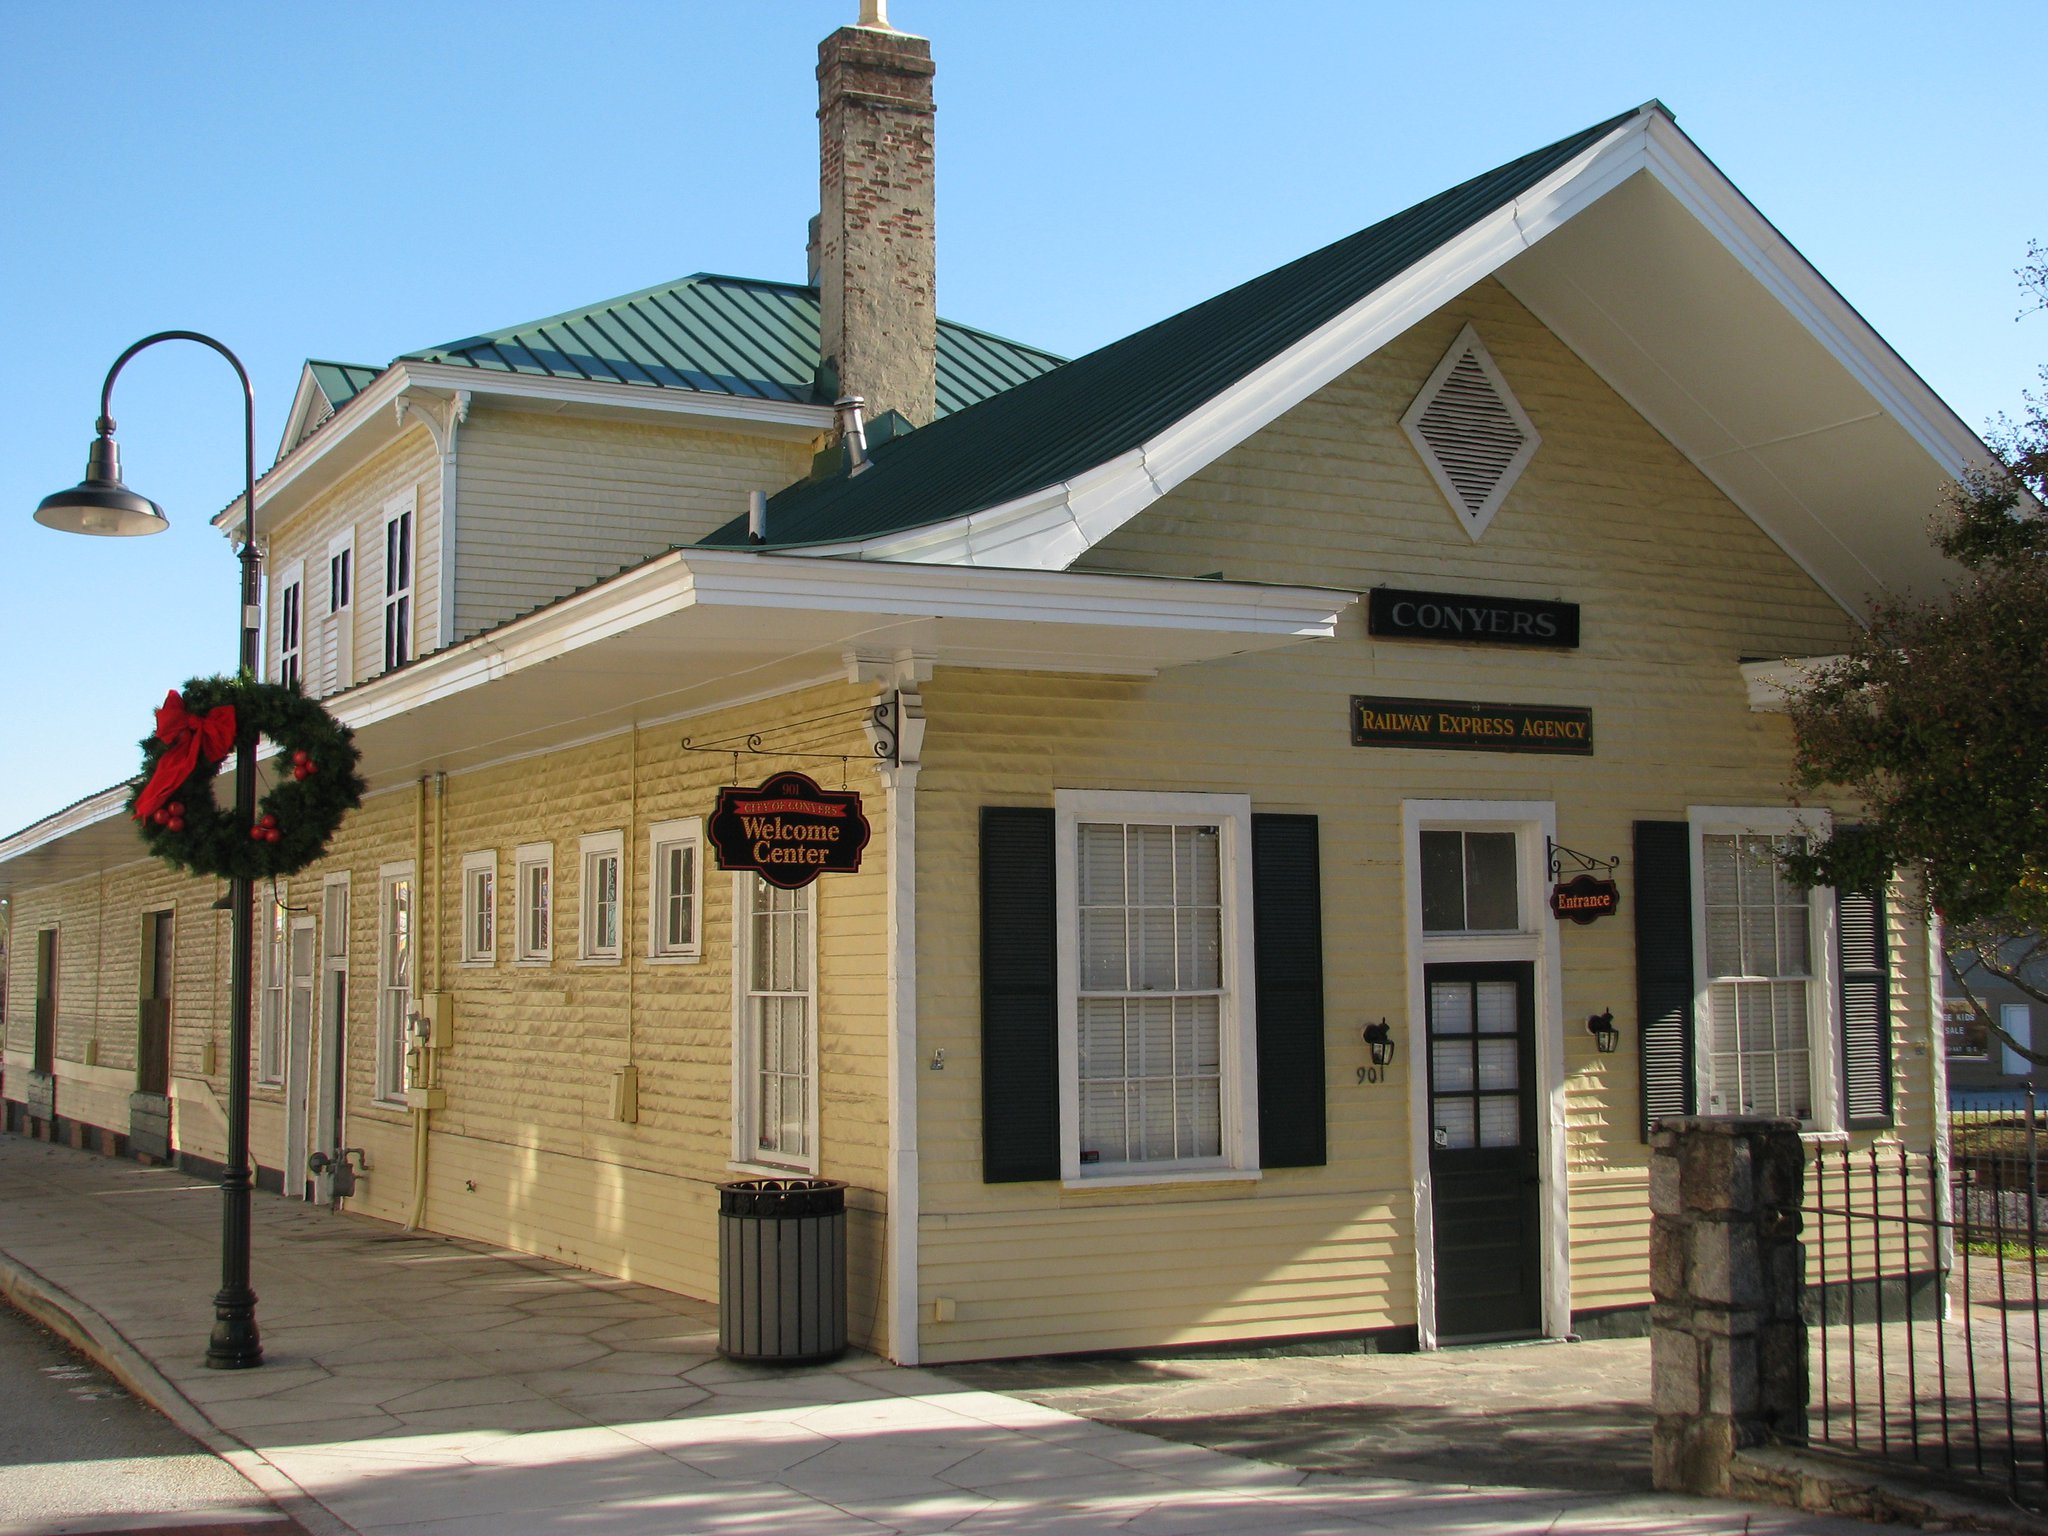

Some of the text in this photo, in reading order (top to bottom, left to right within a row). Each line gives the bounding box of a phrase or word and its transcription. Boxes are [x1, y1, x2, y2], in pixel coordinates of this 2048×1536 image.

[1391, 601, 1558, 638] CONYERS
[1362, 709, 1586, 739] RAILWAY EXPRESS AGENCY
[782, 783, 800, 796] 901
[744, 801, 837, 815] CITY OF CONYERS
[740, 815, 841, 842] Welcome
[752, 840, 830, 864] Center
[1558, 893, 1611, 910] Entrance
[1945, 1026, 1964, 1034] SALE
[1356, 1066, 1384, 1084] 901
